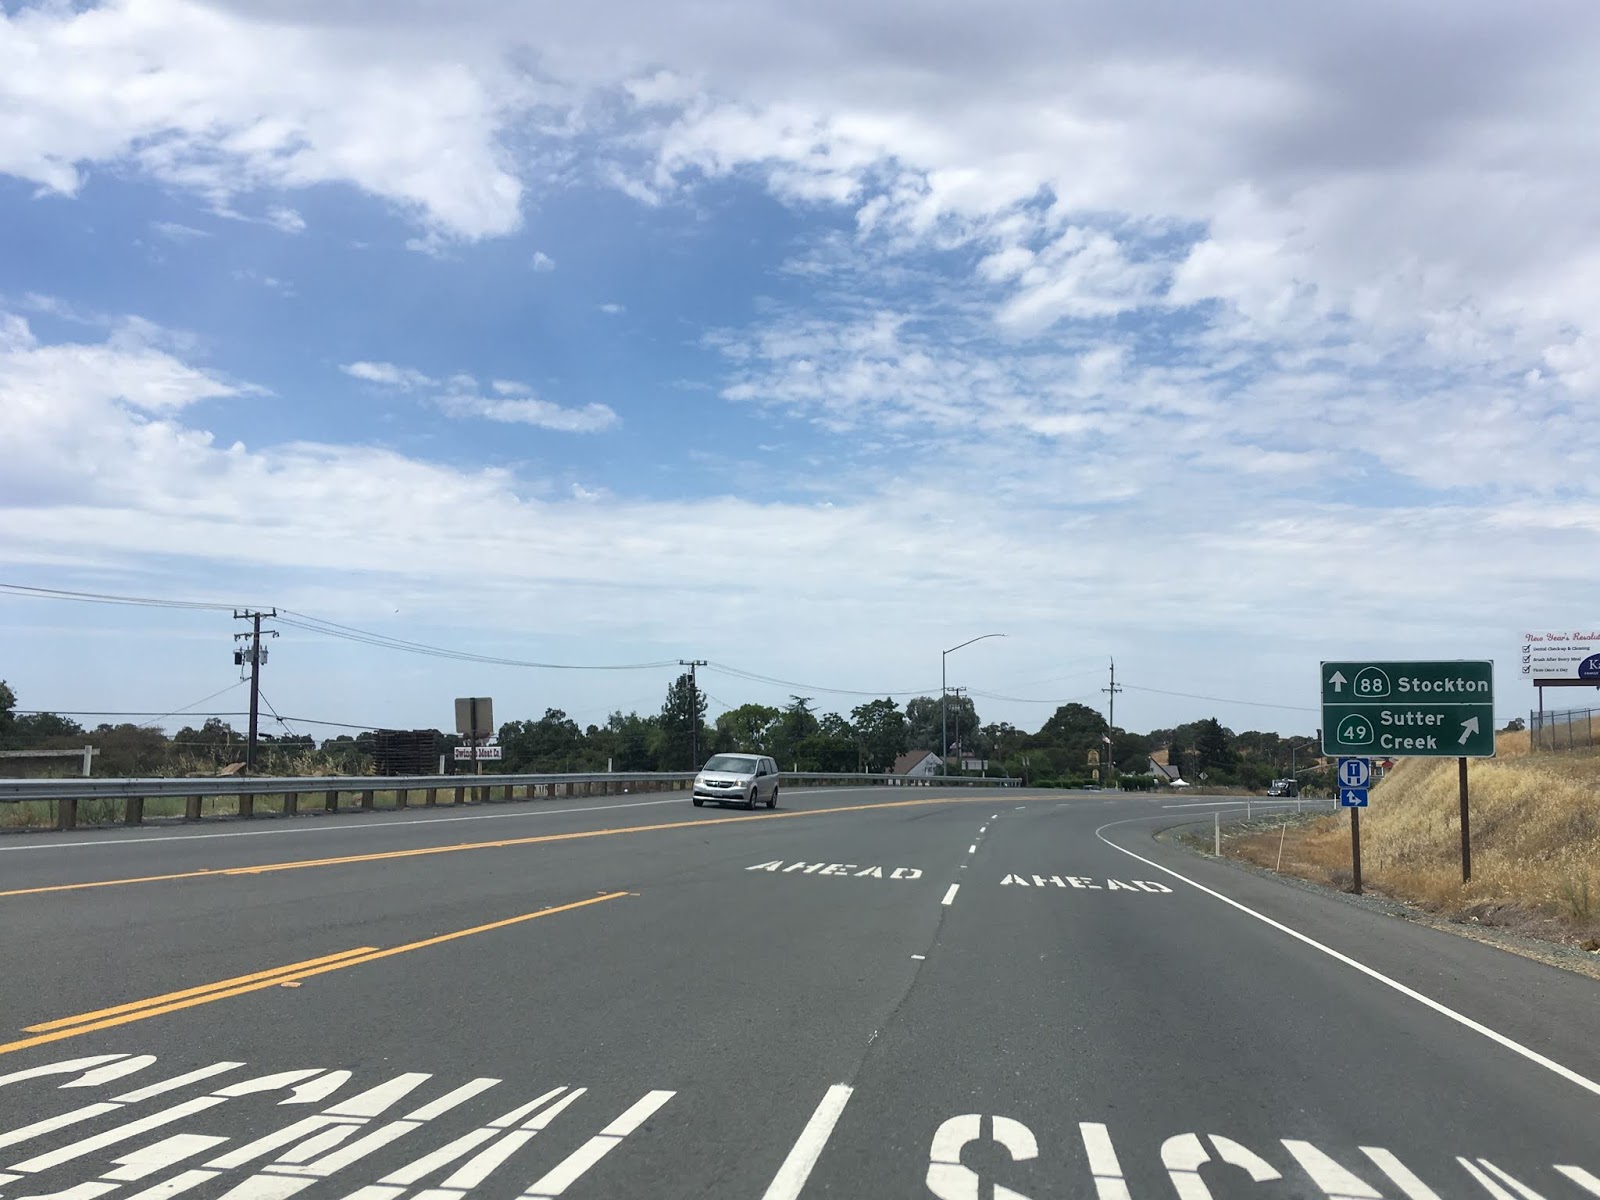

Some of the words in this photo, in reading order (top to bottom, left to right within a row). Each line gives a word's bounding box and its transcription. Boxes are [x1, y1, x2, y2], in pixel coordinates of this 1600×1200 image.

[1525, 633, 1543, 641] New
[1546, 632, 1570, 641] Year's
[1360, 678, 1383, 692] 88
[1398, 676, 1488, 692] Stockton
[1380, 710, 1444, 726] Sutter
[1344, 725, 1367, 740] 49
[1380, 734, 1438, 750] Creek
[744, 860, 923, 879] AHEAD
[1000, 874, 1173, 892] AHEAD
